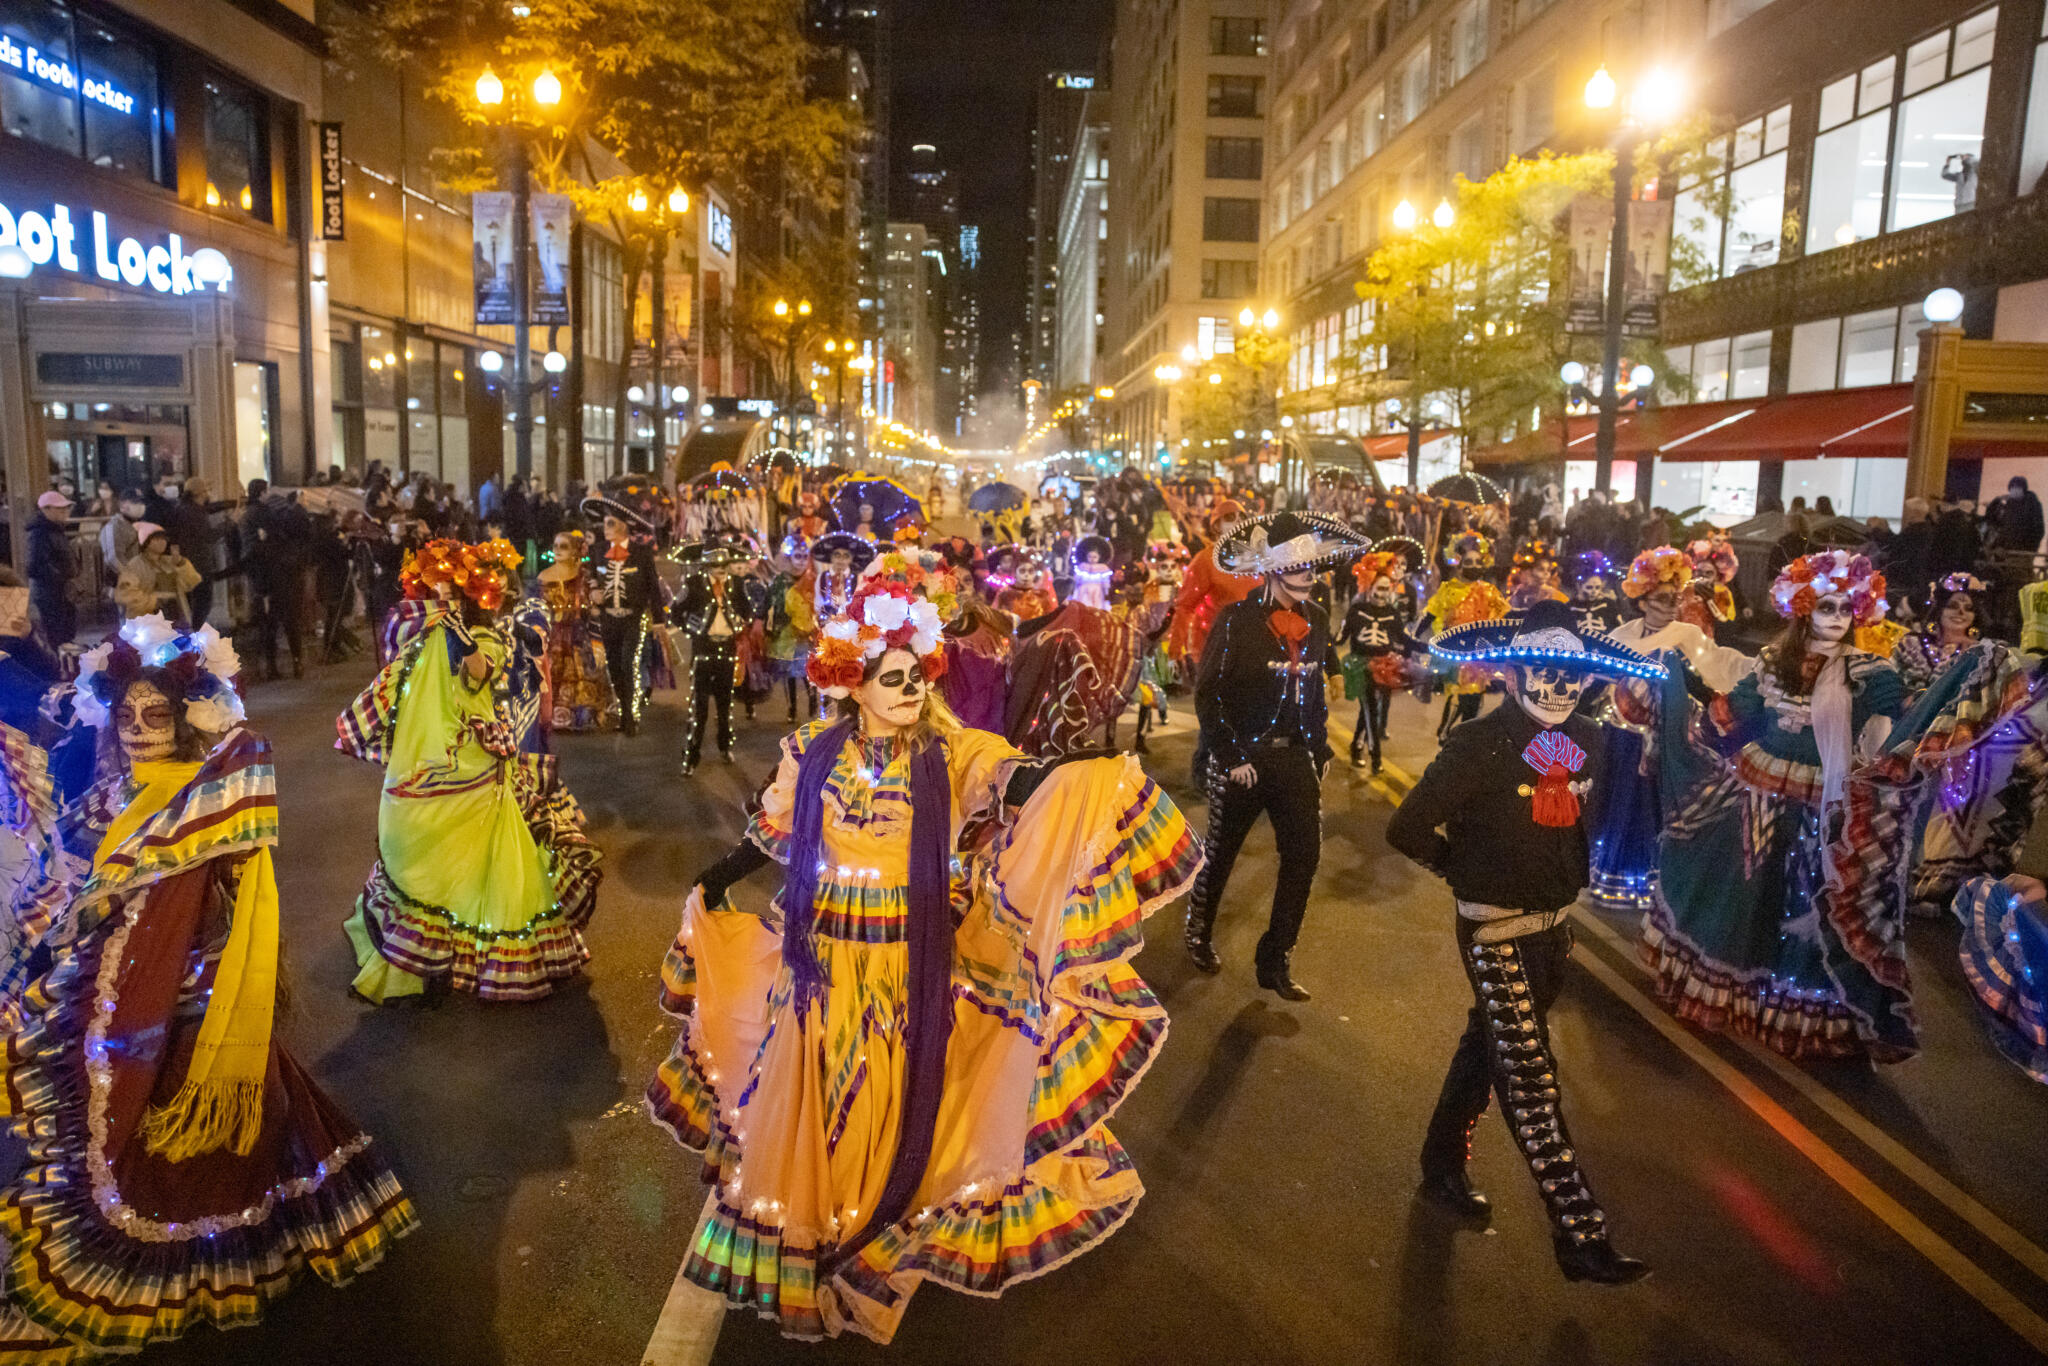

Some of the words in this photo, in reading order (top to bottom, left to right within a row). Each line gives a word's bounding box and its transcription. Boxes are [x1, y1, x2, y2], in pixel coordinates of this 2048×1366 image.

[27, 46, 73, 89] Foot
[74, 75, 134, 115] ocker
[324, 128, 340, 191] Locker
[325, 197, 342, 236] Foot
[84, 356, 142, 371] SUBWAY
